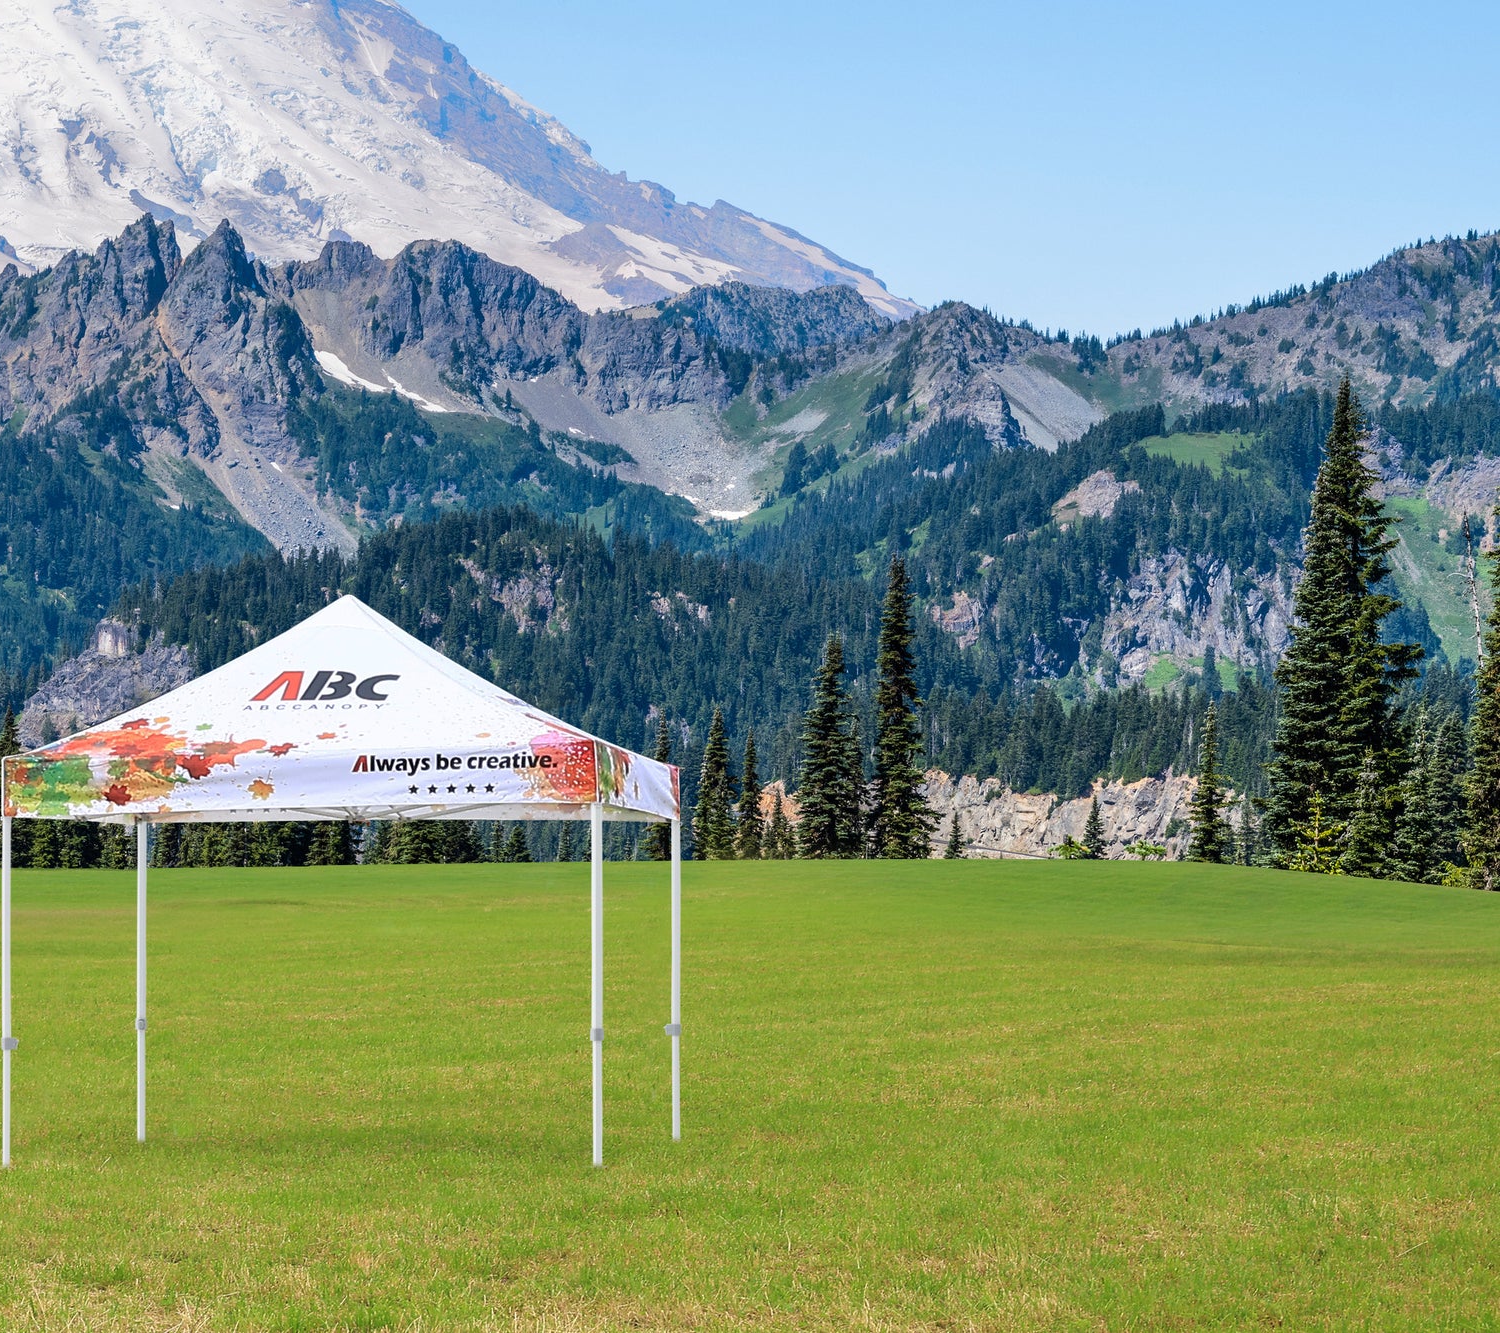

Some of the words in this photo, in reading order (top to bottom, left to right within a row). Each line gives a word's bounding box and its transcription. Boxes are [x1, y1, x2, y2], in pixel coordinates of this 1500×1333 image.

[249, 670, 401, 701] ABC
[243, 703, 384, 711] ABCCANOPY
[352, 754, 430, 776] Always
[436, 754, 461, 770] be
[467, 751, 558, 769] creative.
